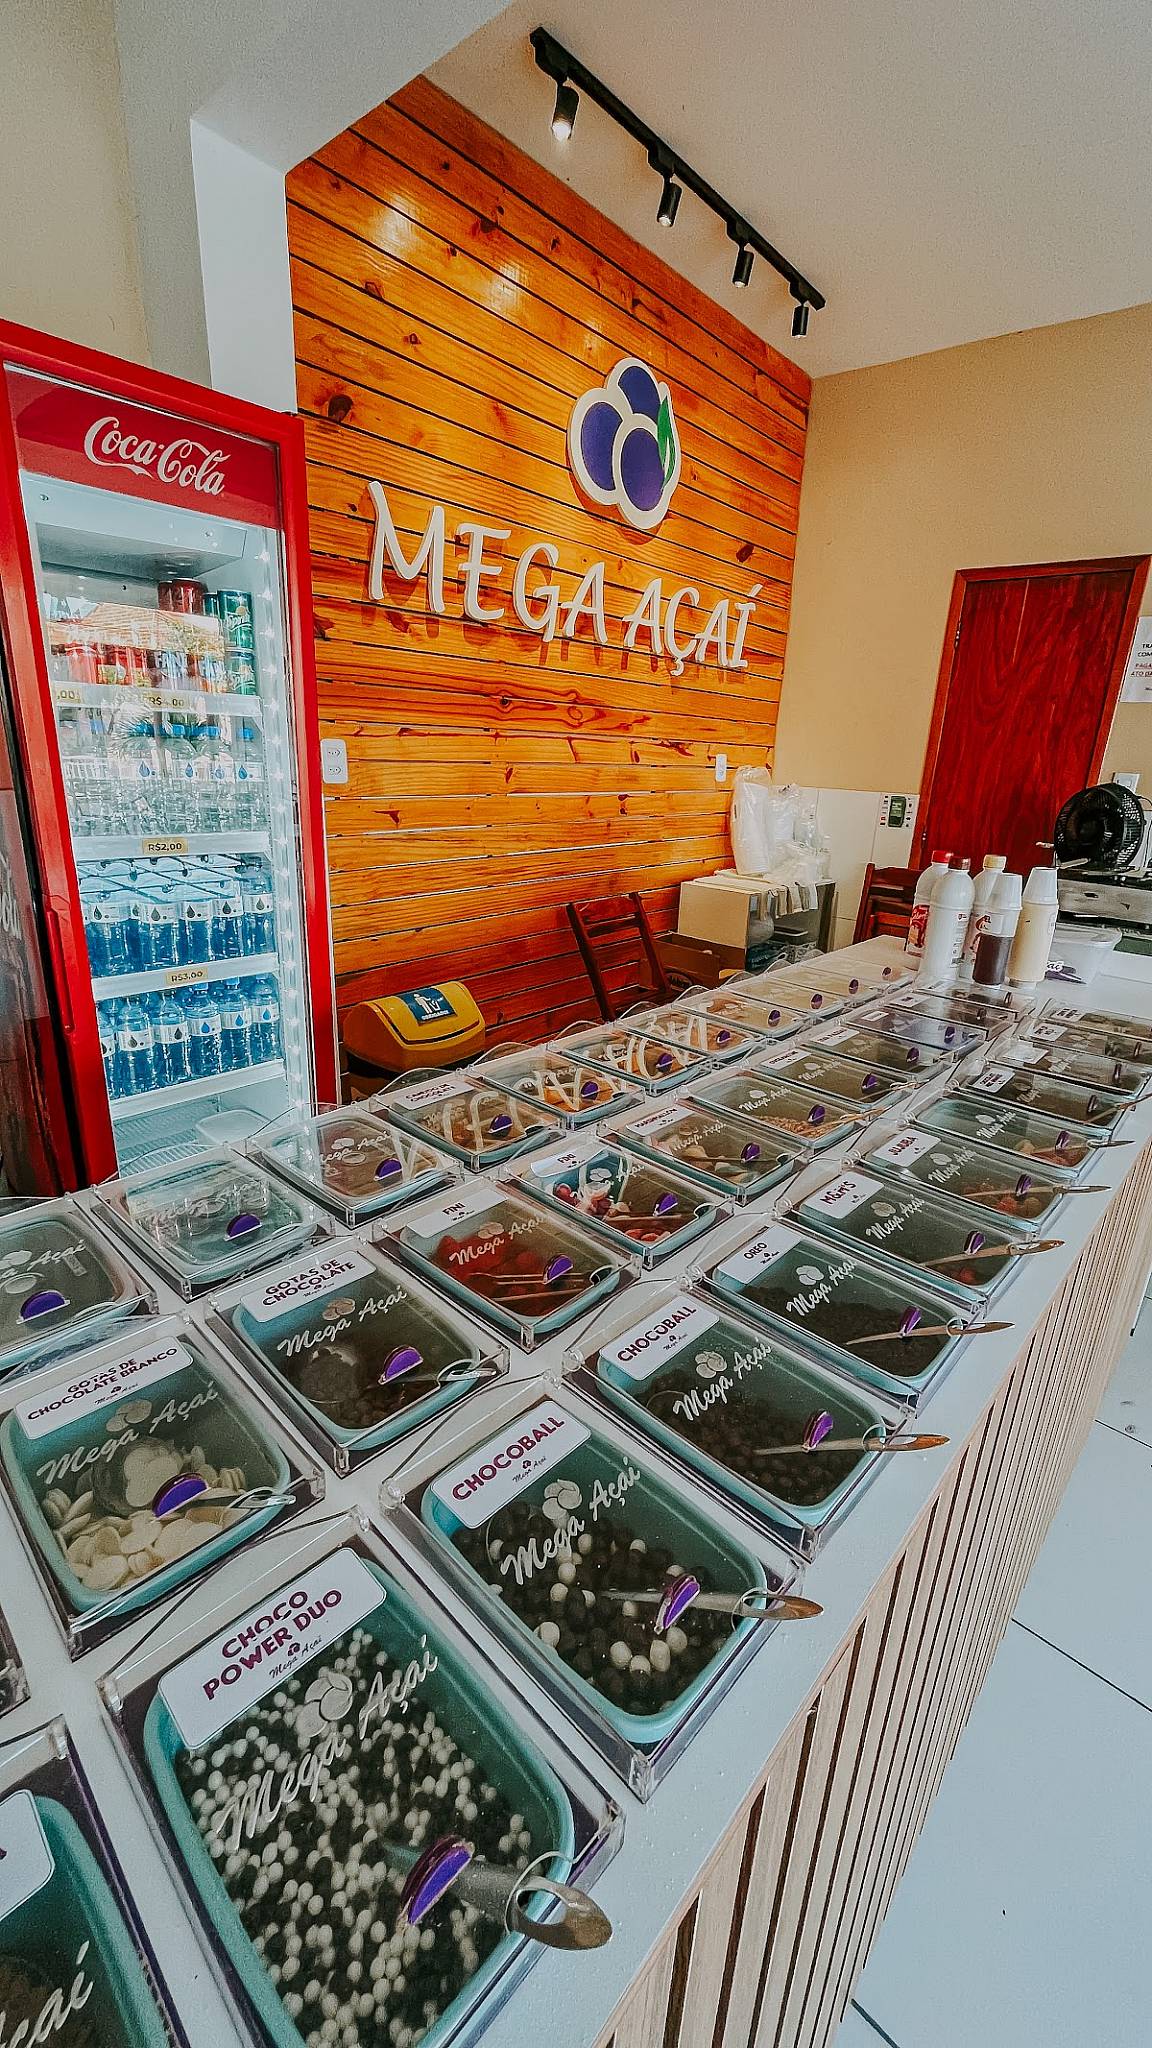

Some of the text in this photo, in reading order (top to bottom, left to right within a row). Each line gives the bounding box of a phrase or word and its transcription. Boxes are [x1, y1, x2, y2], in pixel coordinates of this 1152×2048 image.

[84, 416, 231, 496] Coca-Cola
[368, 480, 762, 677] MEGA AÇAÍ
[148, 842, 182, 851] R$2,00
[442, 1202, 466, 1215] FINI
[449, 1237, 505, 1265] Mega
[743, 1242, 768, 1260] OREO
[262, 1261, 356, 1307] CHOCOLATE
[265, 1259, 341, 1295] GOTAS DE
[786, 1283, 832, 1316] Mega
[277, 1318, 352, 1357] Mega
[617, 1306, 697, 1362] CHOCOBALL
[28, 1348, 178, 1420] CHOCOLATE BRANCO
[67, 1358, 137, 1394] GOTAS DE
[673, 1376, 734, 1421] Mega
[36, 1429, 139, 1485] Mega
[452, 1417, 565, 1500] CHOCOBALL
[500, 1516, 585, 1586] Mega
[203, 1590, 342, 1700] POWER DUO
[222, 1591, 308, 1658] CHOCO
[269, 1655, 298, 1678] Mega
[215, 1736, 347, 1850] Mega
